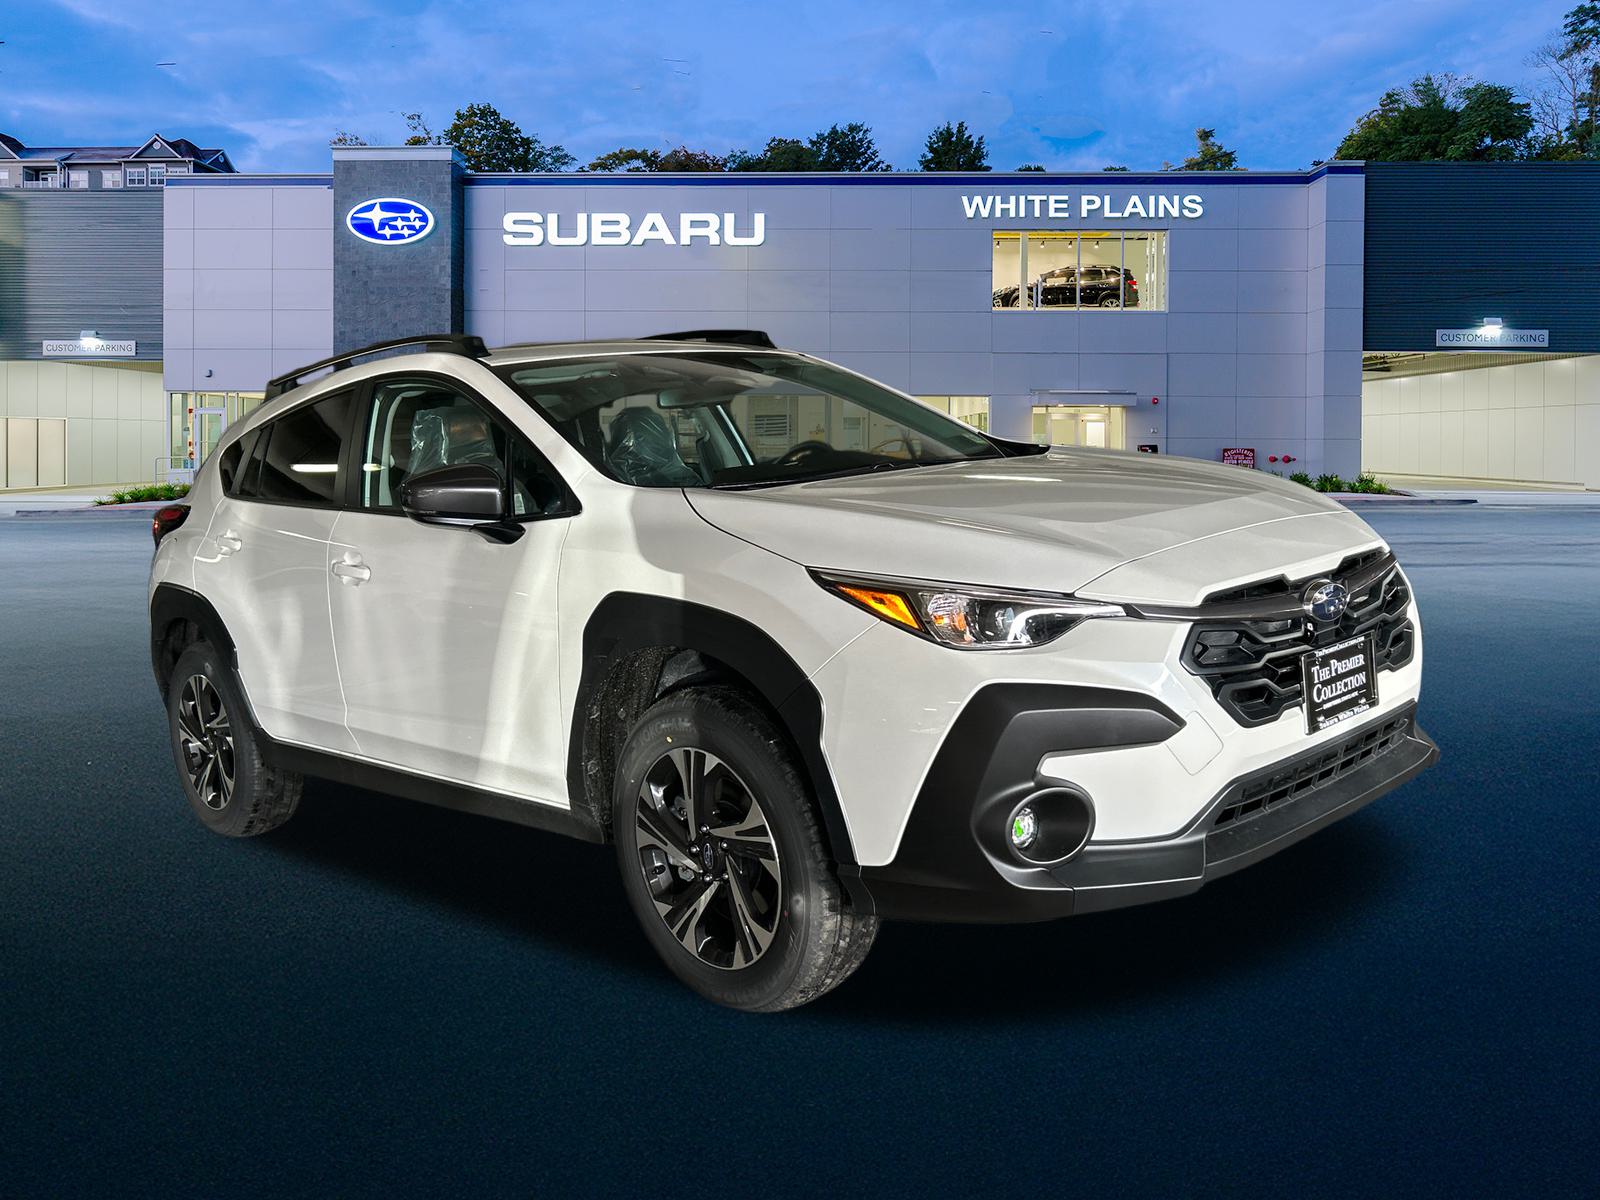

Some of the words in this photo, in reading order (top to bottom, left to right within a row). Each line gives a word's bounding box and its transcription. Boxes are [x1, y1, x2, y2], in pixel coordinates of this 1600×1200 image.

[960, 194, 1070, 219] WHITE
[1080, 194, 1205, 219] PLAINS
[502, 211, 766, 247] SUBARU
[45, 344, 92, 352] CUSTOMER
[95, 344, 133, 352] PARKING
[1440, 333, 1496, 343] CUSTOMER
[1501, 333, 1546, 343] PARKING
[1311, 665, 1331, 684] THE
[1330, 654, 1365, 677] PREMIER
[1313, 671, 1366, 703] COLLECTION
